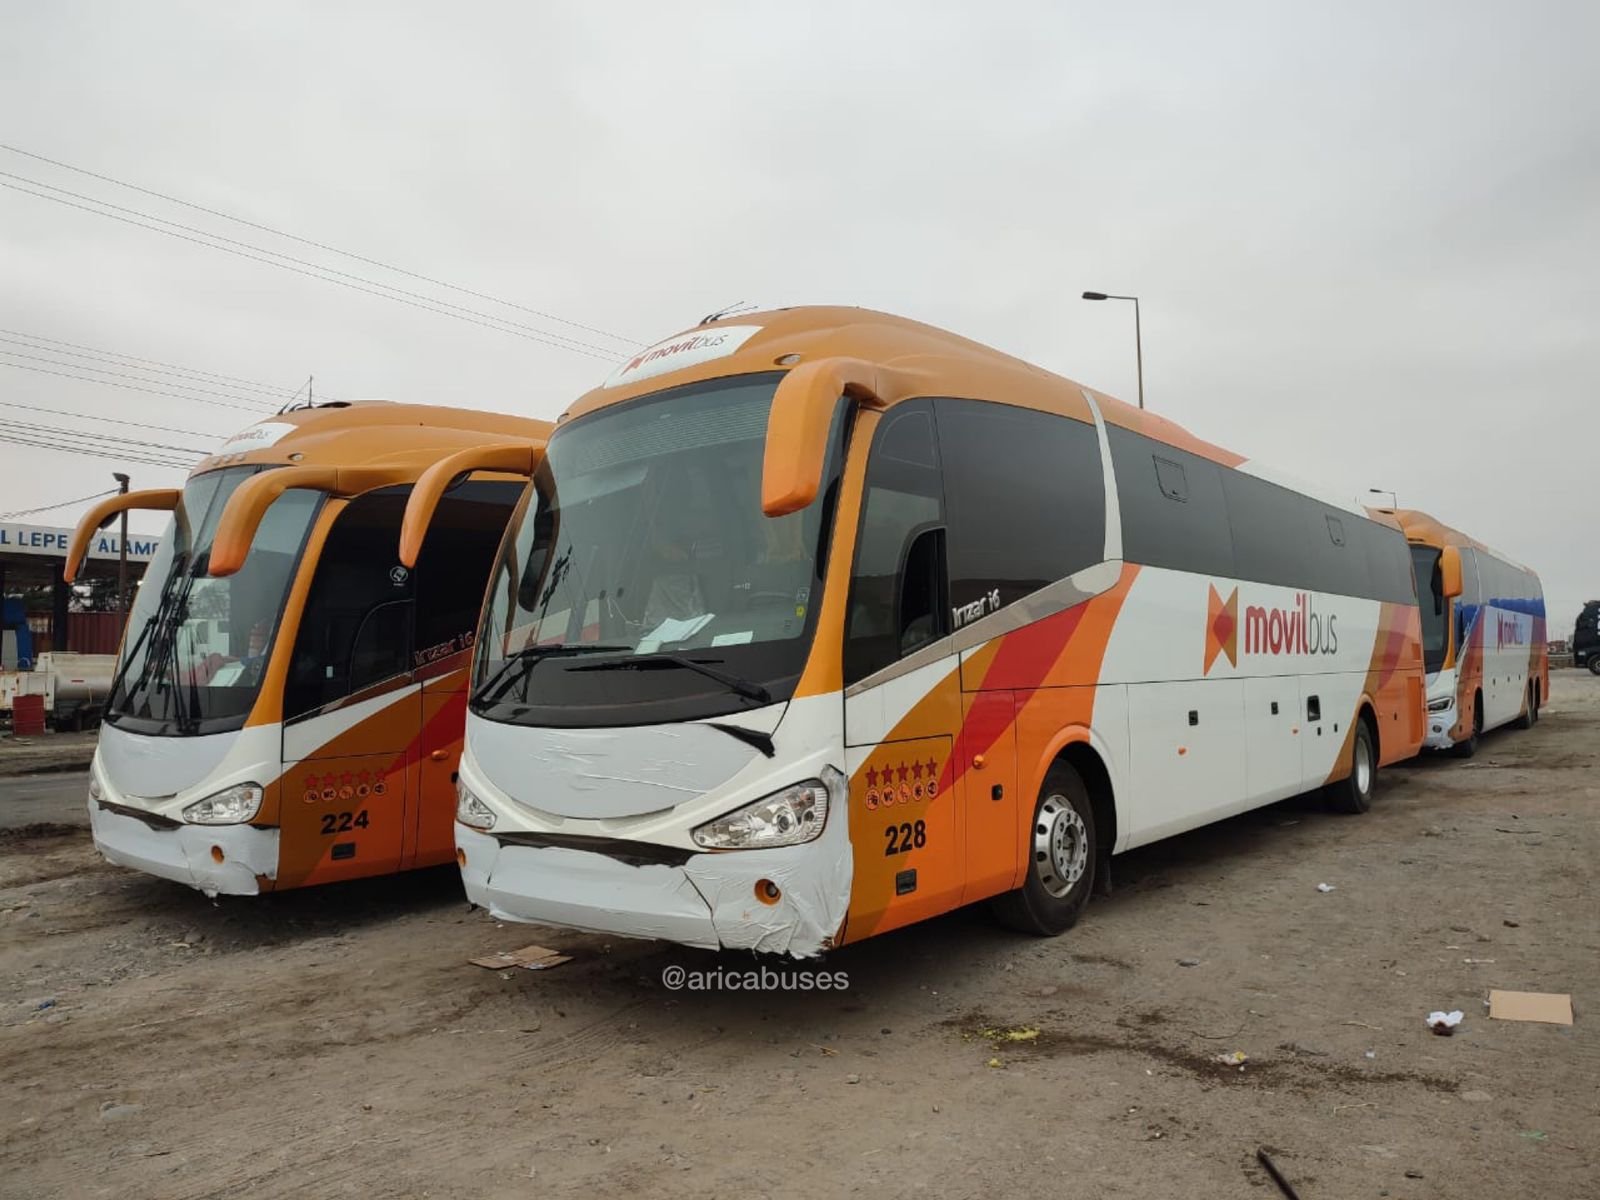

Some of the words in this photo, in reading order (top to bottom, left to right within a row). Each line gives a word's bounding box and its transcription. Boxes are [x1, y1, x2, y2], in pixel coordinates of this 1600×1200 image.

[644, 334, 729, 364] movilbus
[18, 531, 68, 549] LEPE
[1245, 591, 1338, 655] movilbus
[320, 809, 370, 836] 224
[884, 819, 927, 856] 228
